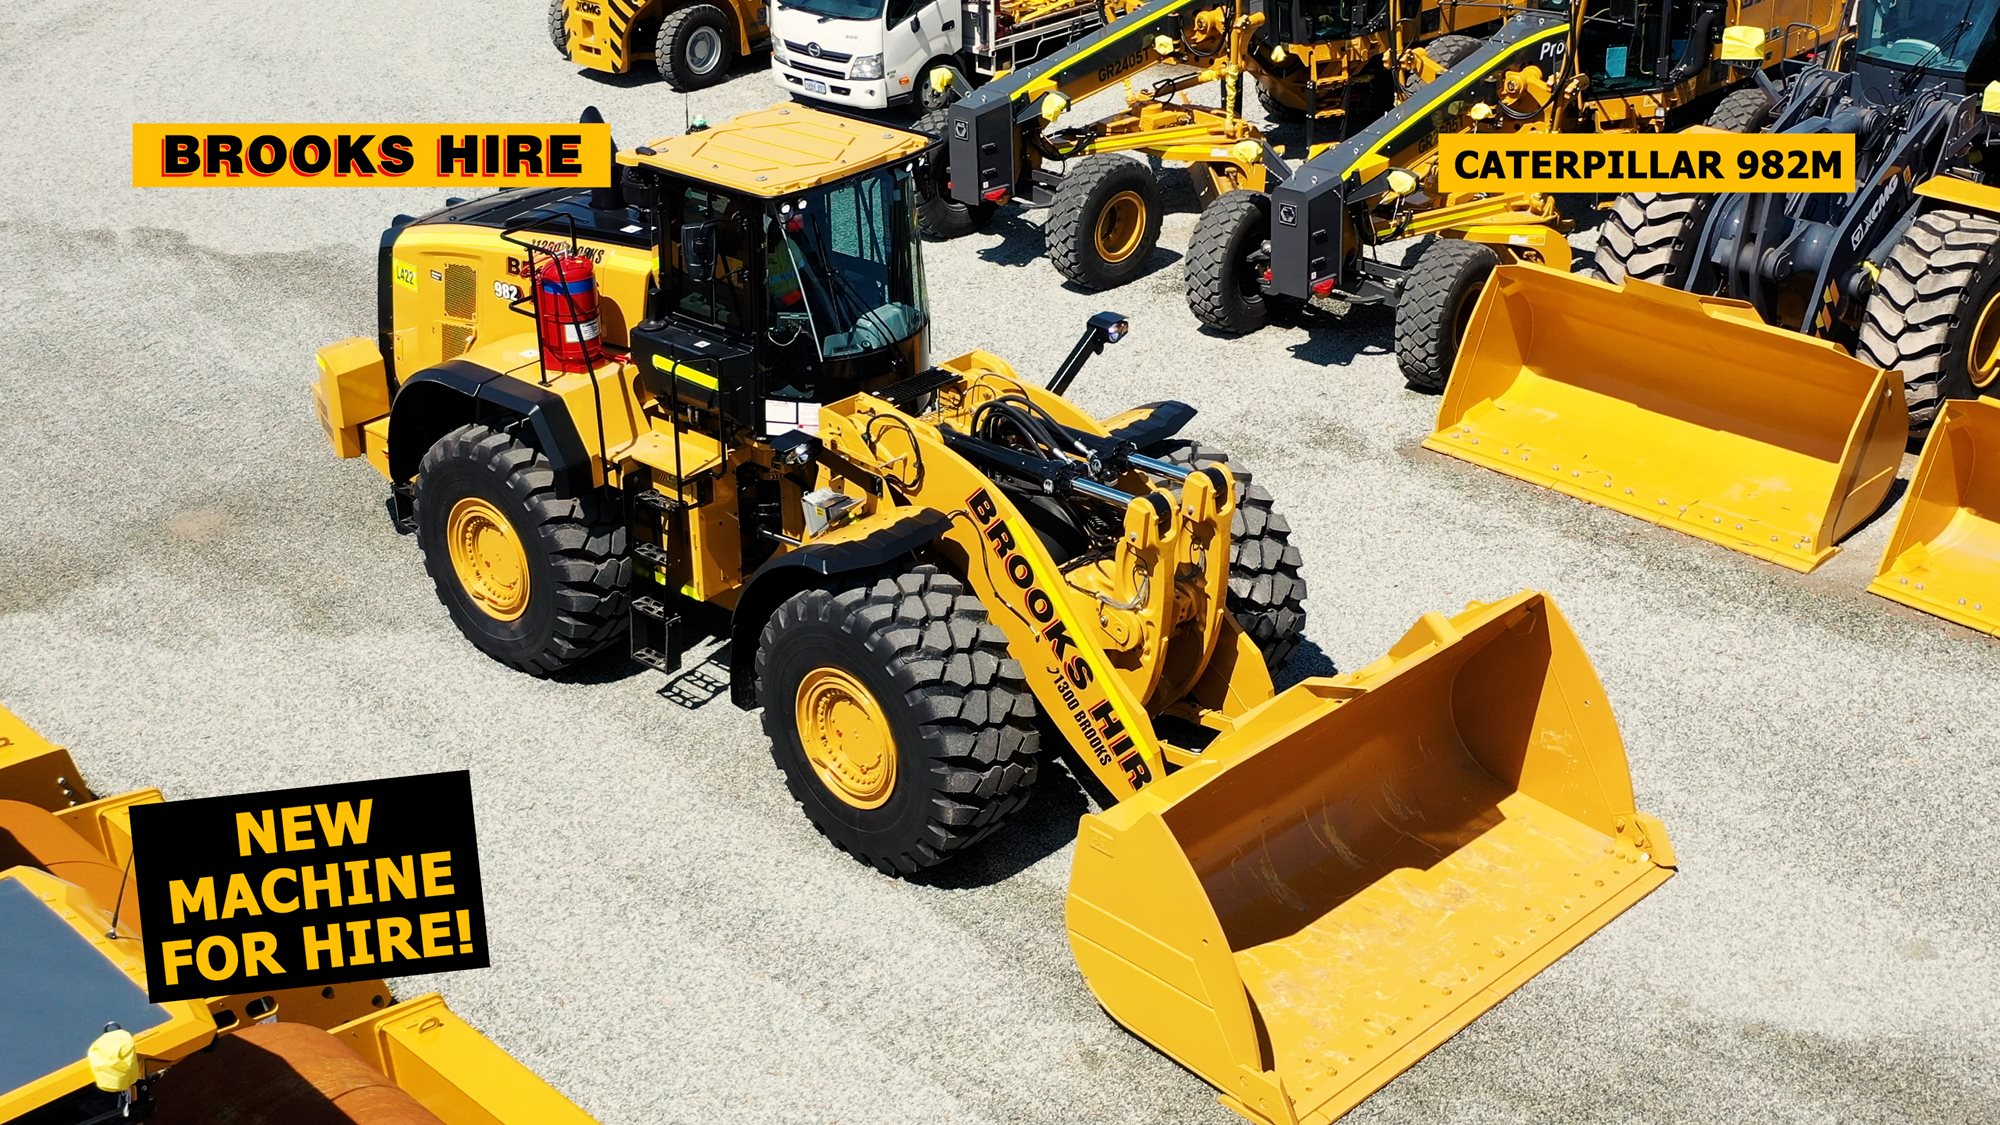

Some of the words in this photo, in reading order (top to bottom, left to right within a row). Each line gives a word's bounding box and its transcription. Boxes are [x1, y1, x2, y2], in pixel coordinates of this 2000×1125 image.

[1098, 46, 1150, 82] GR2405T
[1540, 42, 1565, 60] Pro
[1863, 174, 1899, 237] XCMG
[397, 265, 414, 285] L422
[494, 280, 519, 301] 982
[966, 487, 1094, 690] BROOKS
[1053, 674, 1080, 711] 1300
[1074, 710, 1112, 767] BROOKS
